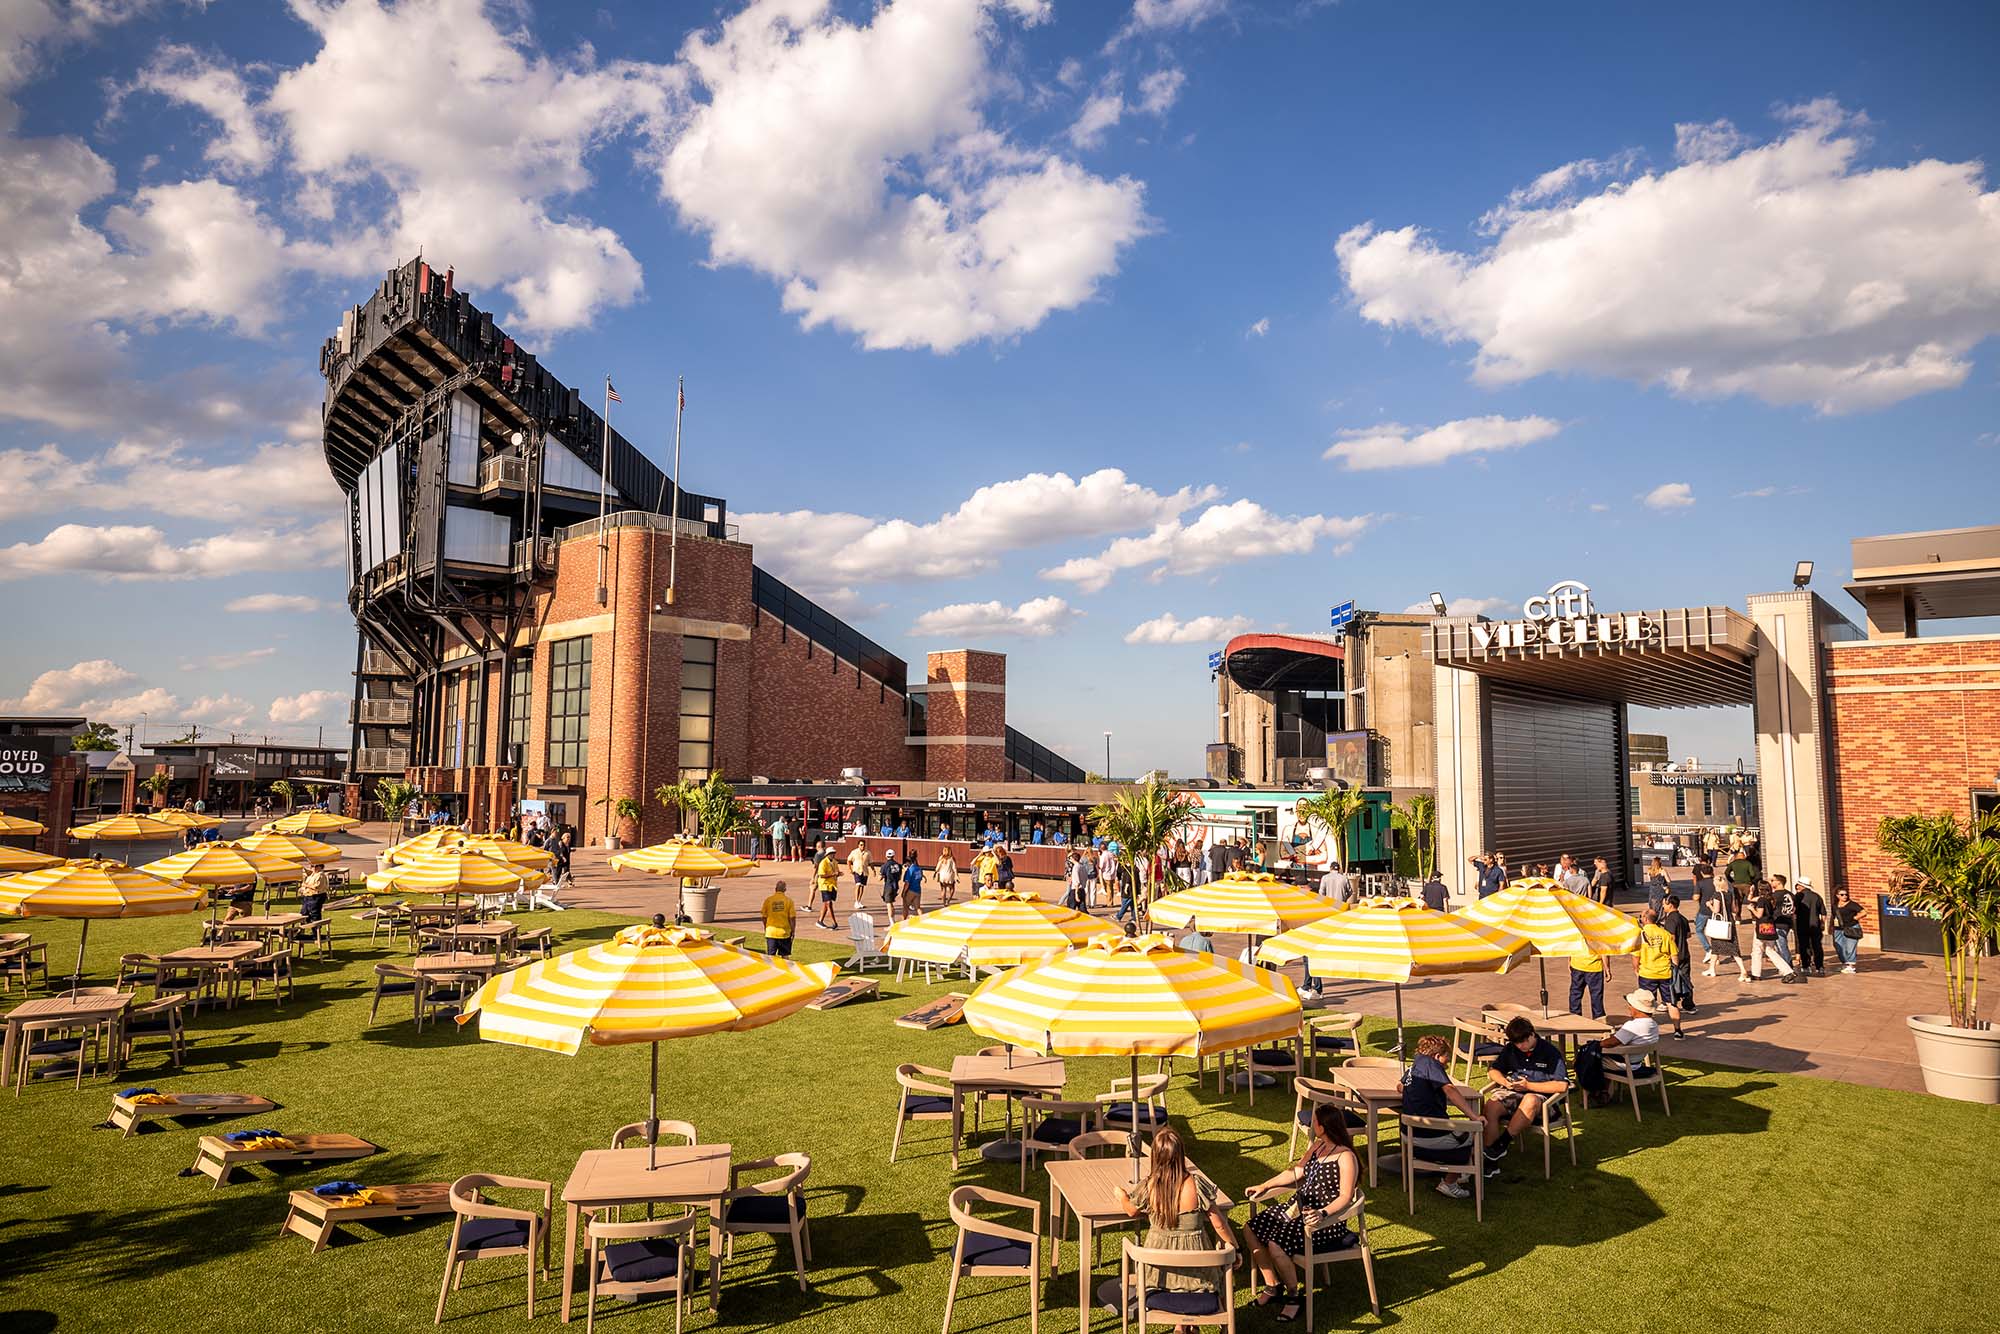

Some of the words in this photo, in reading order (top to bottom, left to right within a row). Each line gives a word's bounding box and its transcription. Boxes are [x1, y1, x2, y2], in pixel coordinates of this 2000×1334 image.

[1523, 582, 1591, 621] citi
[1470, 624, 1538, 650] VIP
[1550, 615, 1653, 646] CLUB
[0, 750, 38, 761] OYED
[502, 771, 509, 780] A
[1661, 775, 1704, 785] Northwell
[937, 787, 967, 801] BAR
[825, 822, 852, 830] BURER
